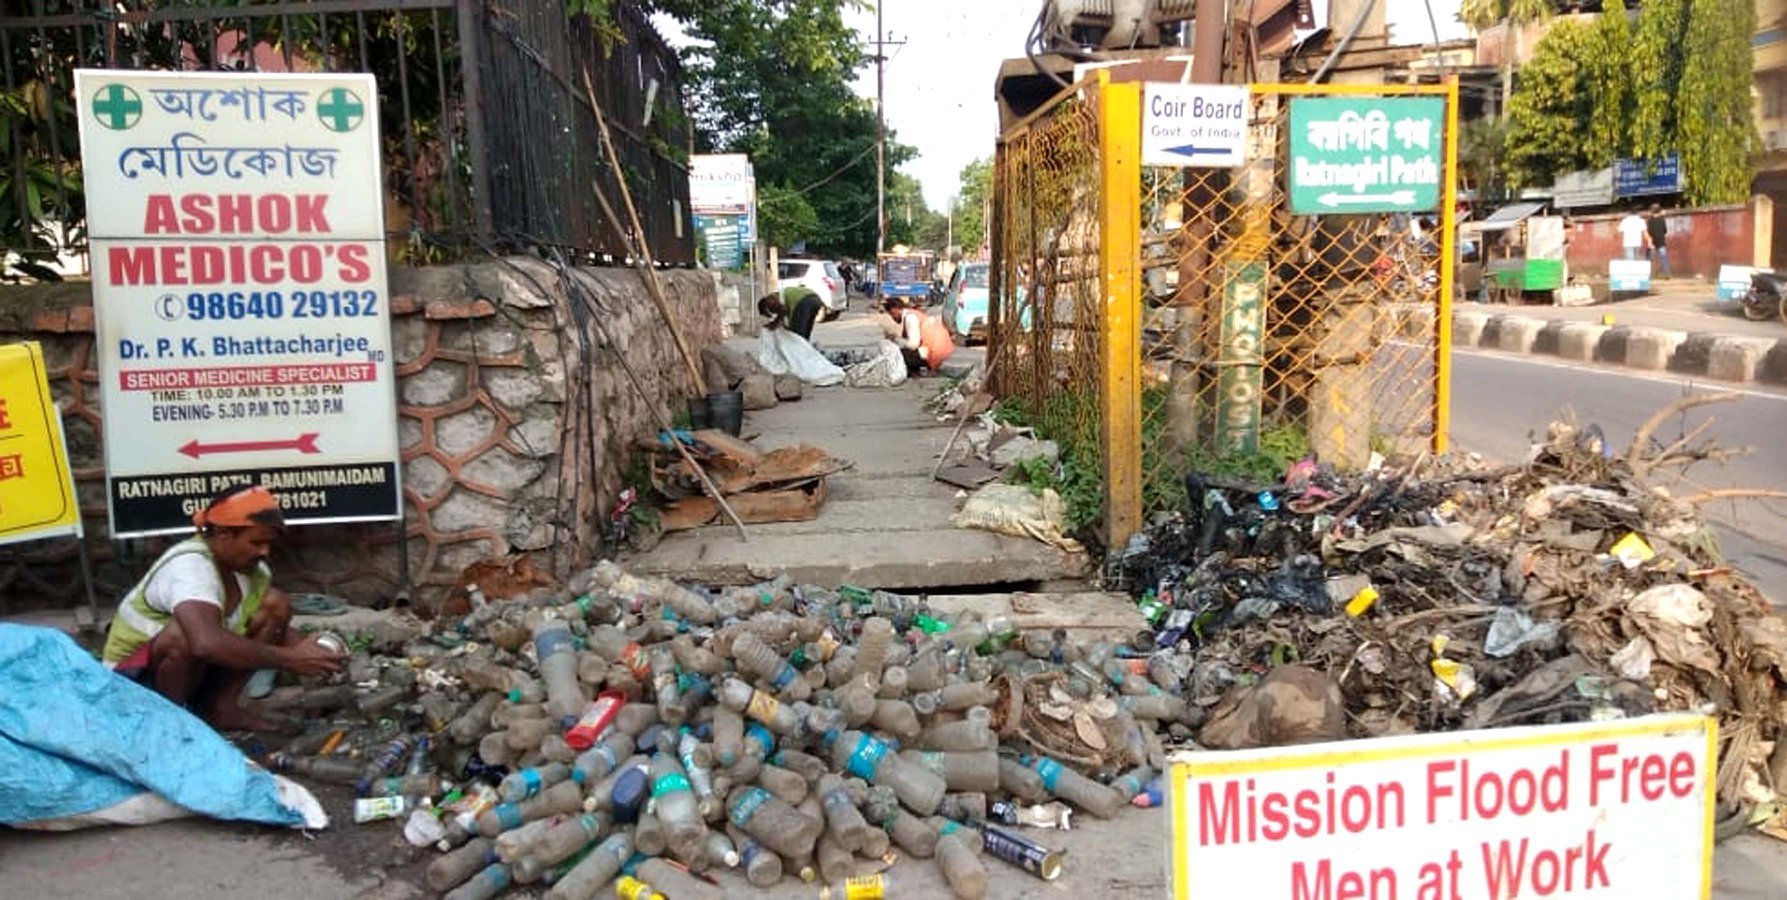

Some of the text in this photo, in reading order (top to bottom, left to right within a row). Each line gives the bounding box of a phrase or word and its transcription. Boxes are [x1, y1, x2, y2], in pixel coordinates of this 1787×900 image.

[149, 86, 308, 122] অশোক
[1151, 94, 1244, 120] Coir Board
[1151, 125, 1241, 140] Govt. of India
[119, 132, 340, 179] মেডিকোজ
[1294, 154, 1438, 193] Ratnagiri Path
[144, 194, 332, 235] ASHOK
[108, 245, 371, 287] MEDICO'S
[187, 290, 378, 320] 98640 29132
[120, 333, 369, 360] Dr. P. K. Bhattacharjee
[368, 350, 384, 362] MD
[127, 365, 370, 388] SENIOR MEDICINE SPECIALIST
[150, 384, 344, 402] TIME: 10.00 AM TO 1.30 PM
[152, 404, 215, 421] EVENING-
[218, 403, 245, 419] 5.30
[274, 401, 290, 415] TO
[294, 400, 320, 414] 7.30
[118, 479, 206, 499] RATNAGIRI
[260, 467, 386, 490] BAMUNIMAIDAM
[1198, 743, 1697, 847] Mission Flood Free
[1292, 830, 1613, 900] Men at Work
